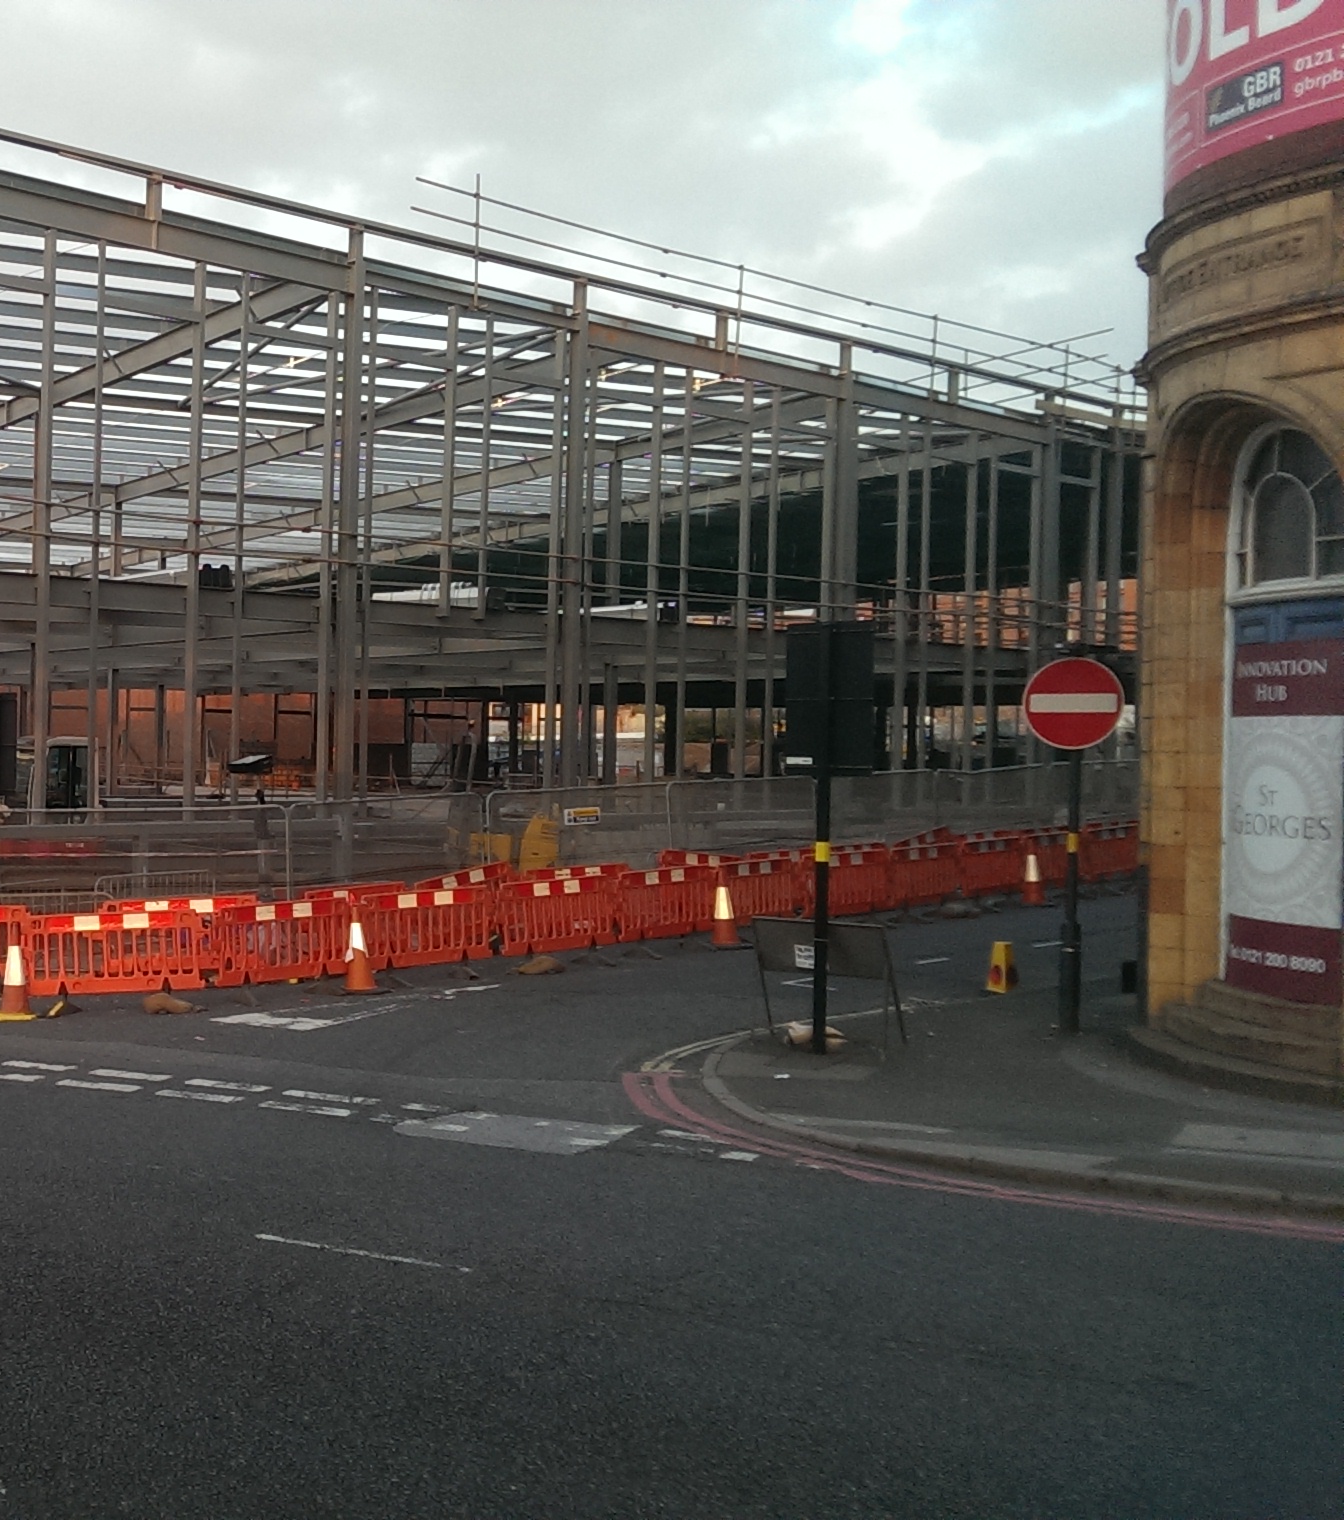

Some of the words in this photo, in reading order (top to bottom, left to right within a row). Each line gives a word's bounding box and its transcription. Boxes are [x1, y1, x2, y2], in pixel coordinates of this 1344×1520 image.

[1293, 48, 1335, 73] 0121
[1242, 66, 1282, 98] GBR
[1236, 659, 1327, 678] INNOVATION
[1255, 683, 1288, 702] HUB
[1234, 804, 1332, 841] GEORGES
